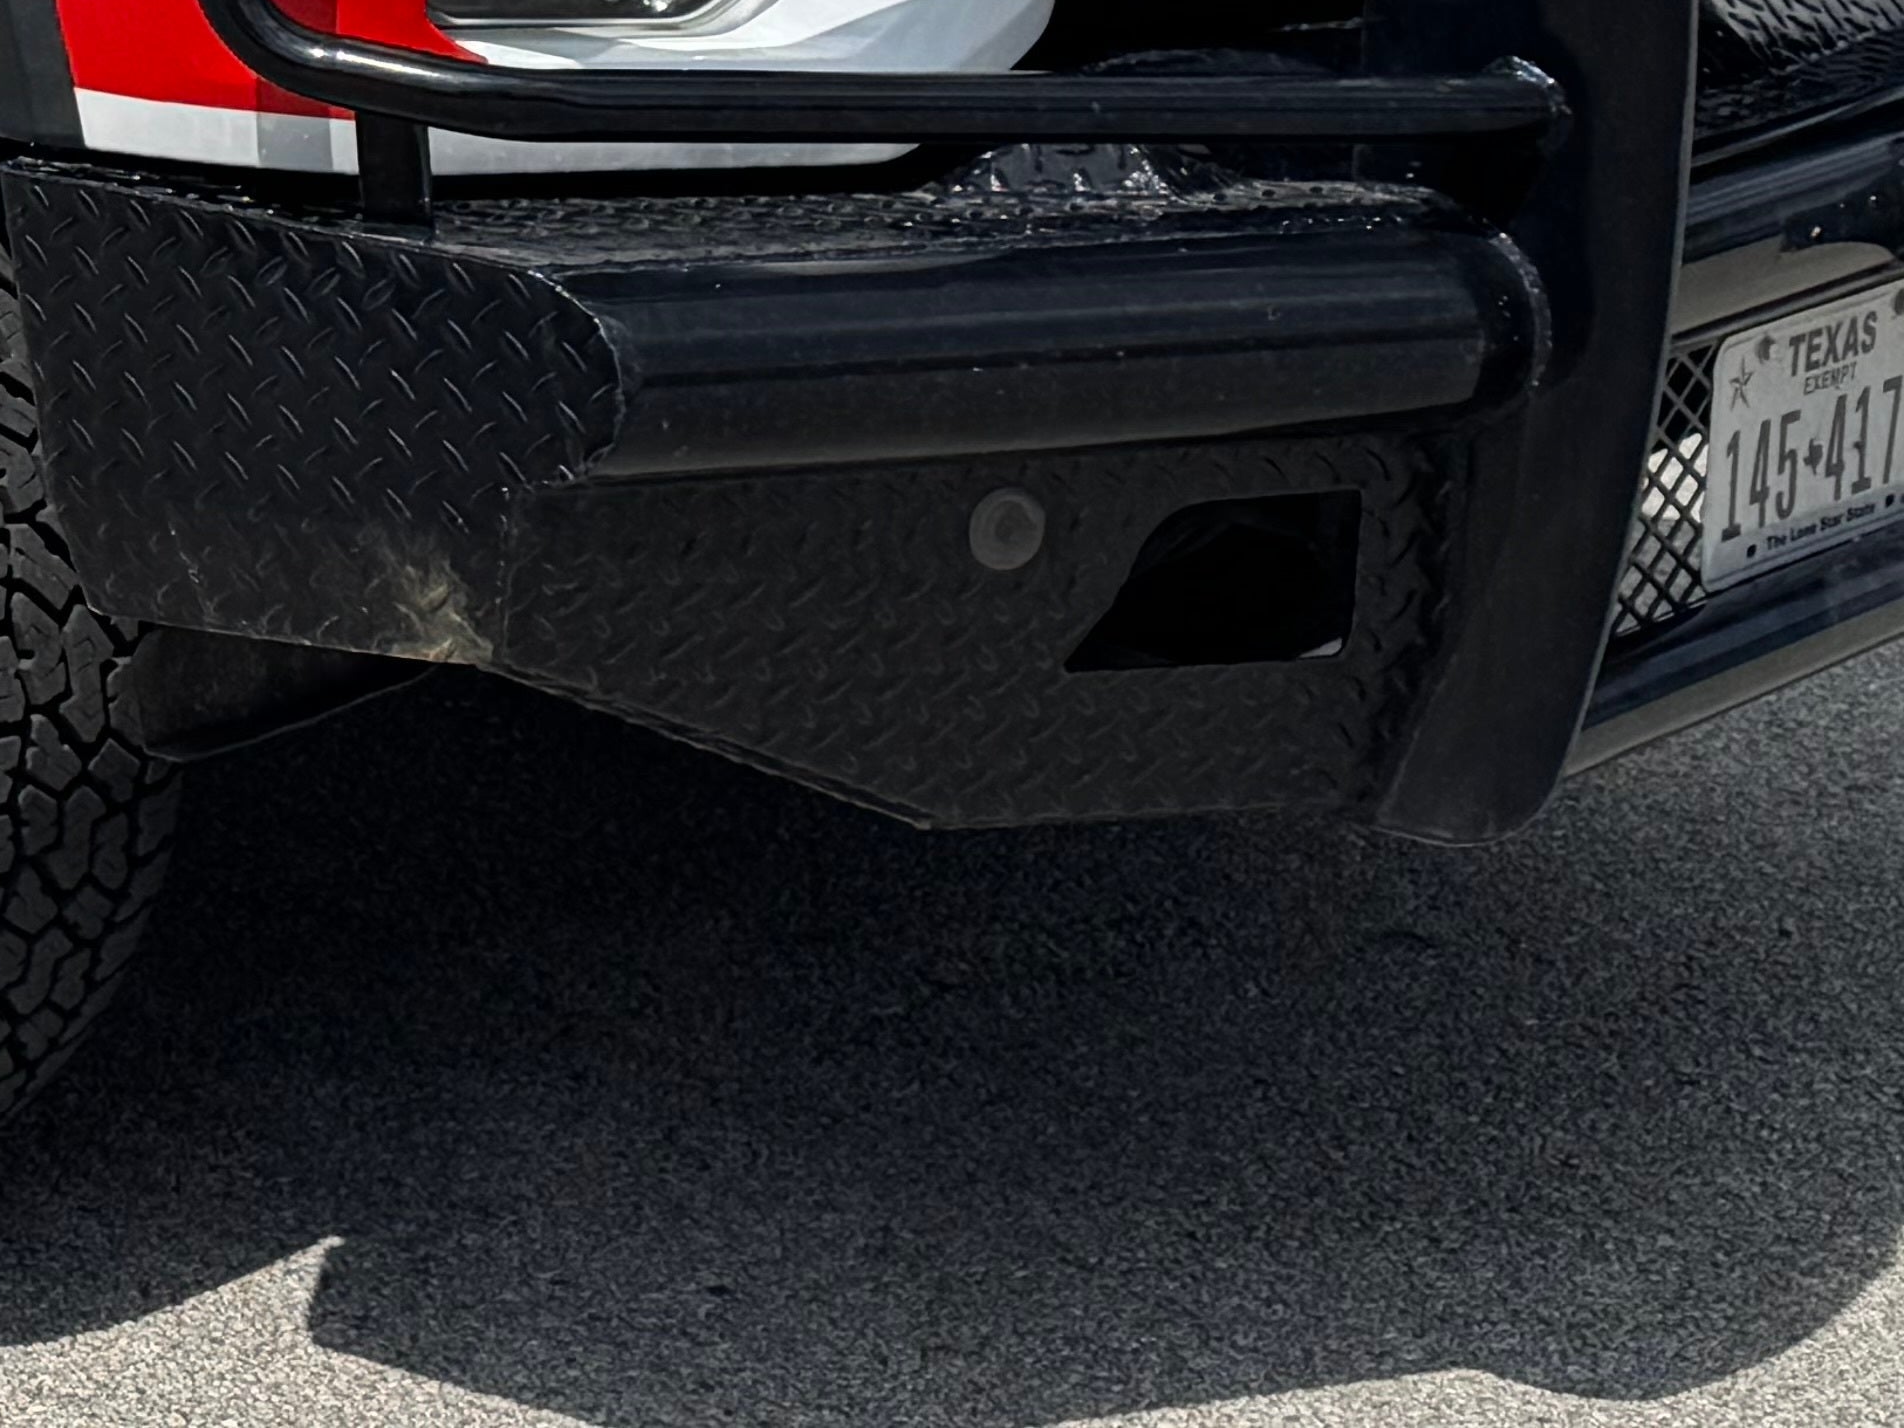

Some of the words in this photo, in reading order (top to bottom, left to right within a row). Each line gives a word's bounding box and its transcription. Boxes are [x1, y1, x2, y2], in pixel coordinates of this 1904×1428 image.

[1788, 310, 1879, 378] TEXAS
[1803, 361, 1858, 396] EXEMPT
[1766, 532, 1788, 551] The
[1789, 522, 1818, 542] Lone
[1820, 512, 1844, 532] Star
[1846, 503, 1877, 522] State
